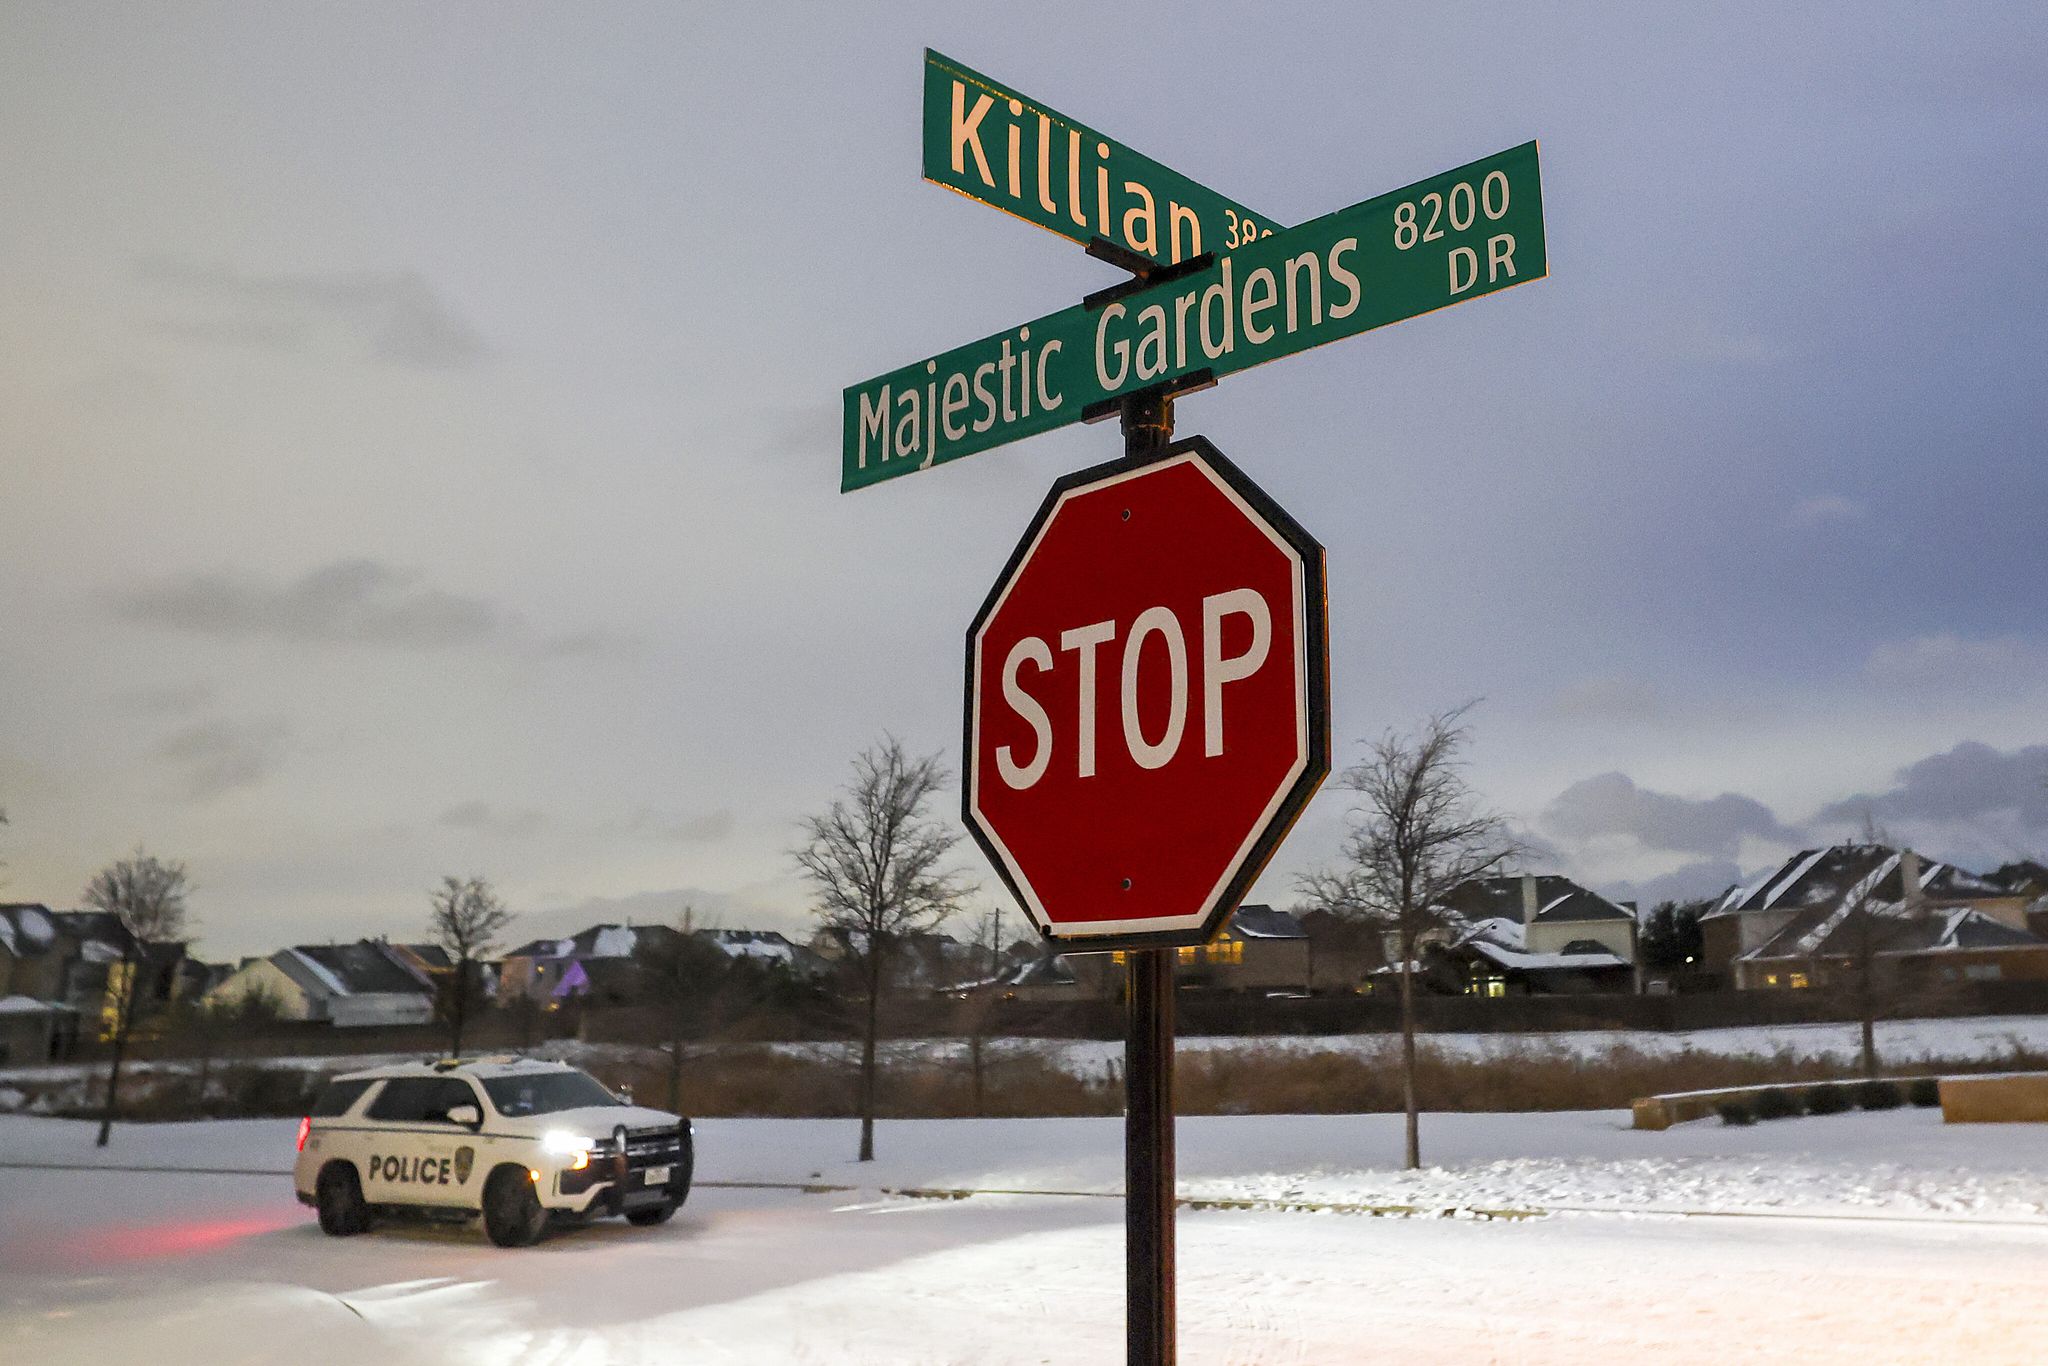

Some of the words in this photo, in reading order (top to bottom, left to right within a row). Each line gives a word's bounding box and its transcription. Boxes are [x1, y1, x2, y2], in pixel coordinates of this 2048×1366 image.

[951, 79, 1202, 265] Killian
[1394, 170, 1510, 250] 8200
[1225, 209, 1273, 250] 38
[1448, 232, 1517, 296] DR
[858, 326, 1063, 471] Majestic
[1096, 237, 1361, 391] Gardens
[995, 587, 1272, 790] STOP
[369, 1154, 451, 1185] POLICE
